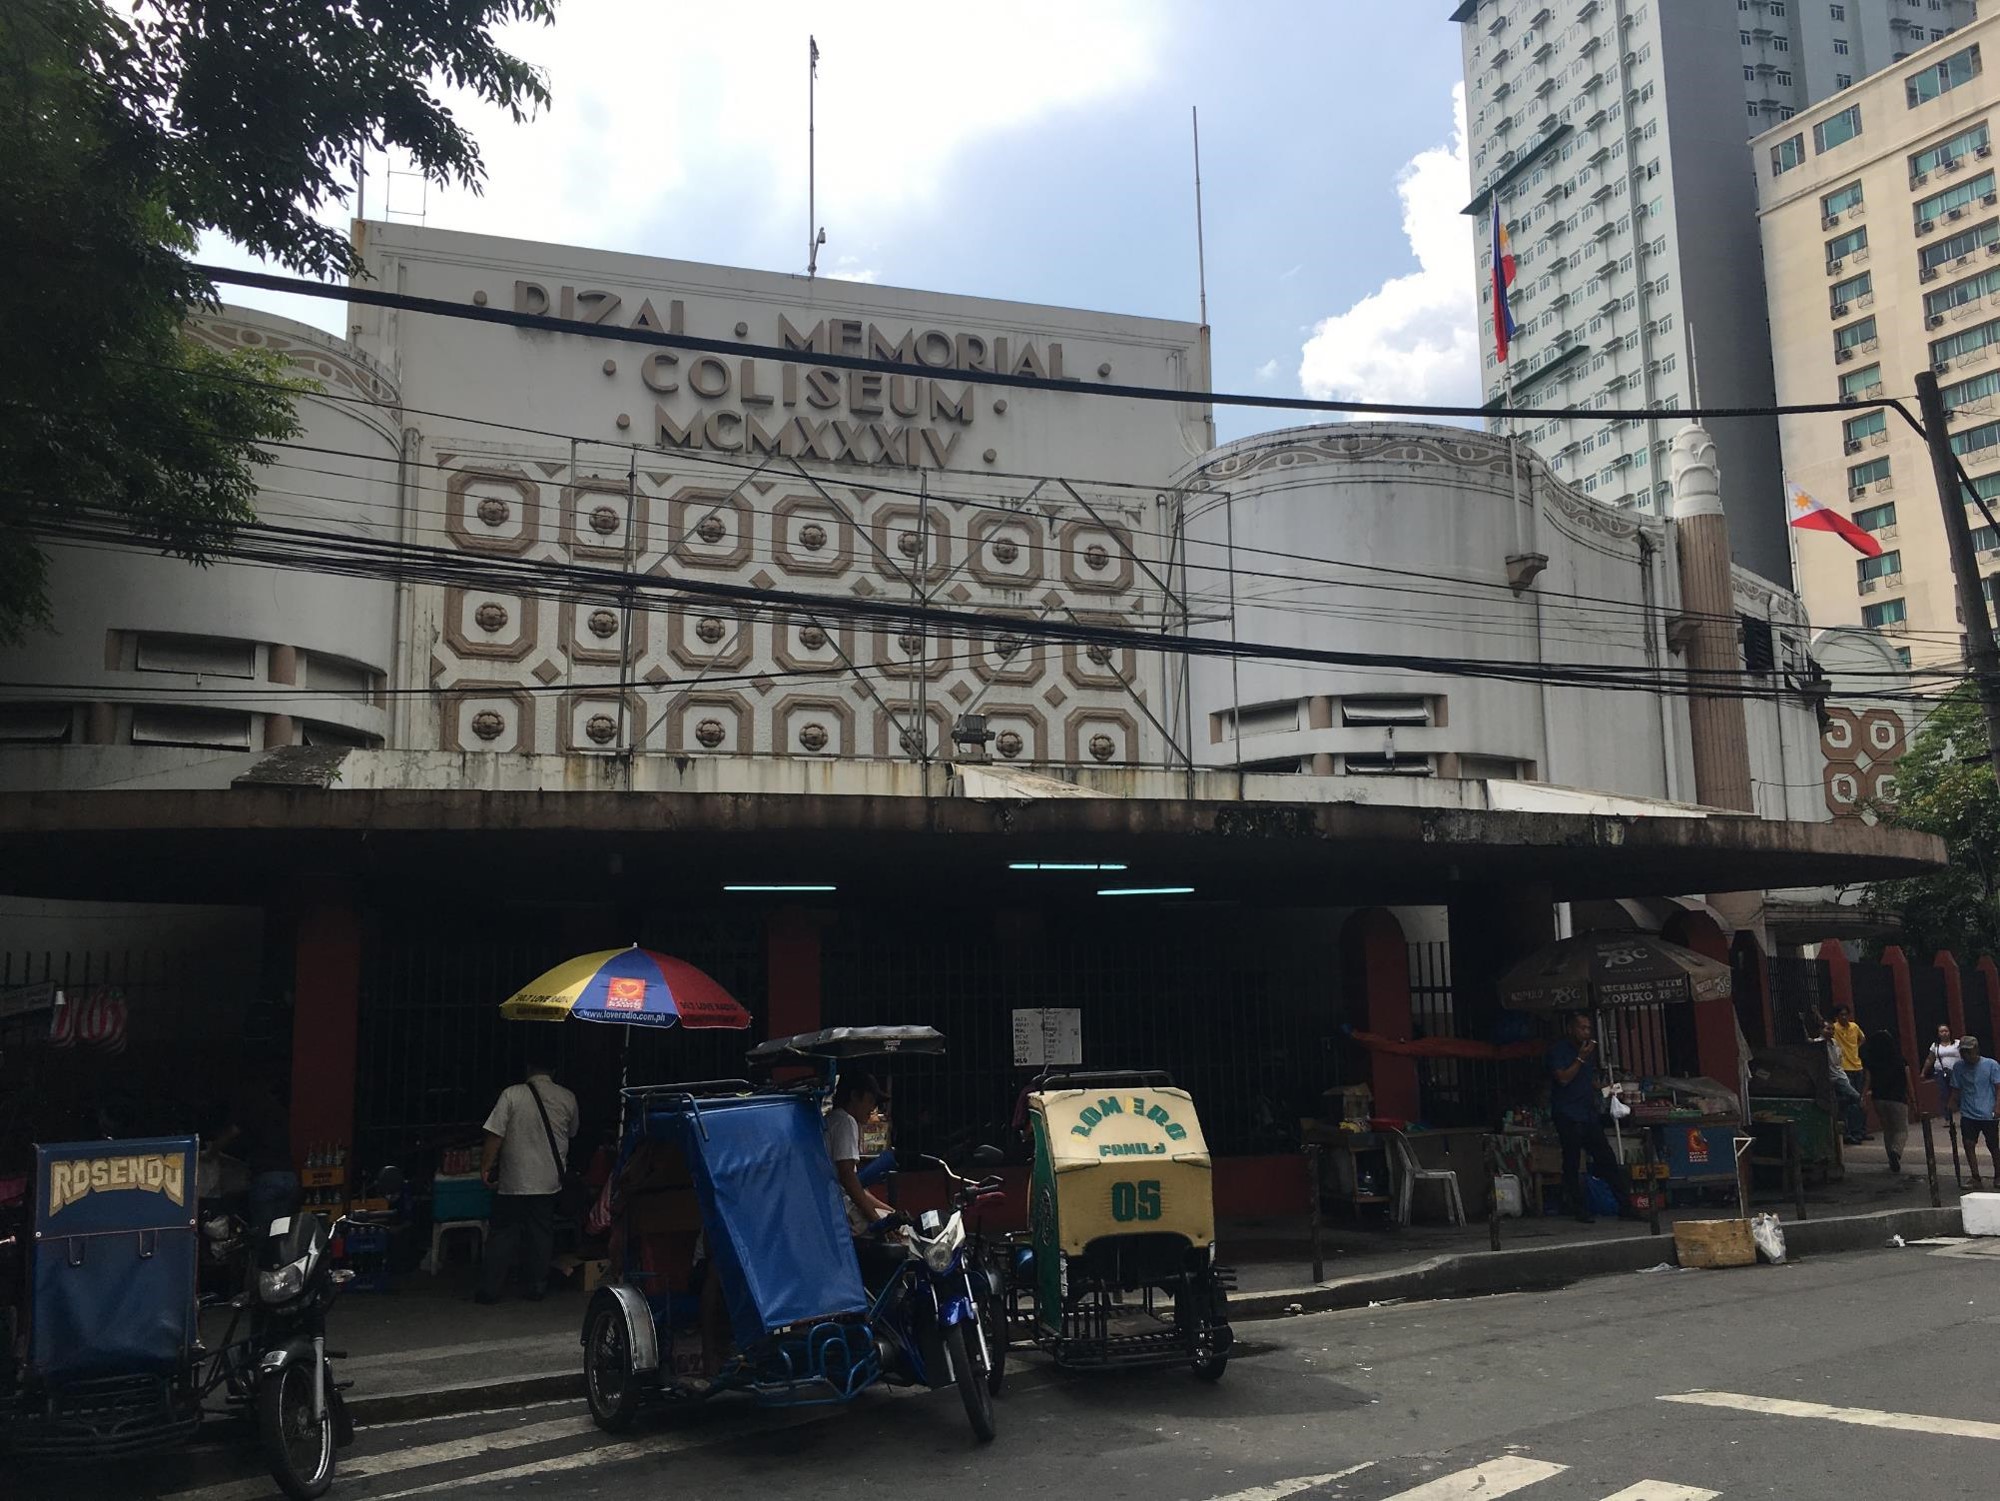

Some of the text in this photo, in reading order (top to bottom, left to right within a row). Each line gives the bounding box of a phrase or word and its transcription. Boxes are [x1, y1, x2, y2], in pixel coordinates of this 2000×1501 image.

[778, 311, 1080, 383] MEMORIAL
[641, 350, 975, 424] COLISEUM
[653, 402, 963, 469] MCMXXXIV
[583, 1009, 666, 1022] www.loveradio.com.ph
[49, 1153, 186, 1218] ROSENDO
